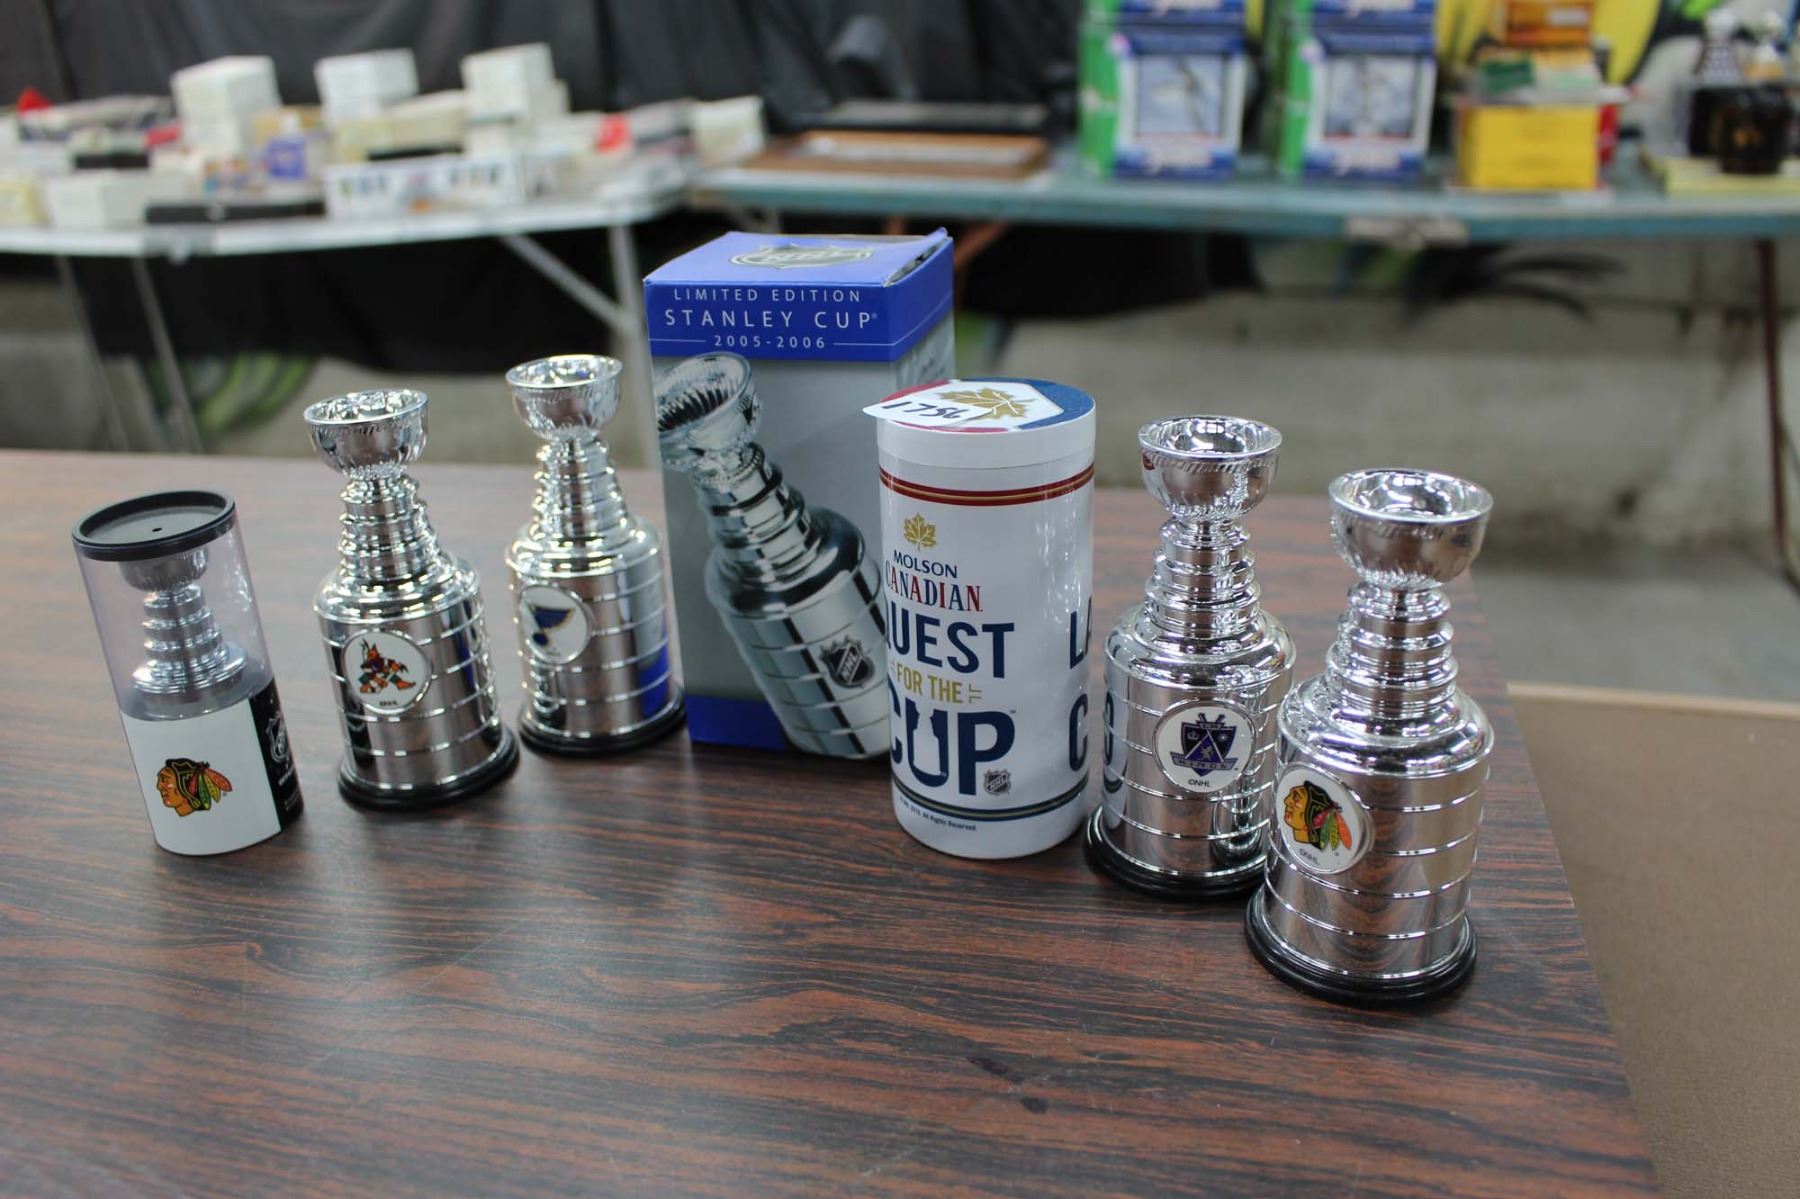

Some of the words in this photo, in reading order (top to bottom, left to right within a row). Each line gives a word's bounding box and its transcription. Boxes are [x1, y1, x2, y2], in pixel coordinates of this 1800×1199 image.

[673, 288, 758, 302] LIMITED
[771, 289, 861, 302] EDITION
[665, 309, 793, 329] STANLEY
[714, 335, 826, 349] 2005-2006
[893, 549, 958, 579] MOLSON
[885, 559, 984, 613] CANADIAN
[888, 600, 1015, 679] UEST
[896, 662, 923, 694] FOR
[927, 674, 964, 704] THE
